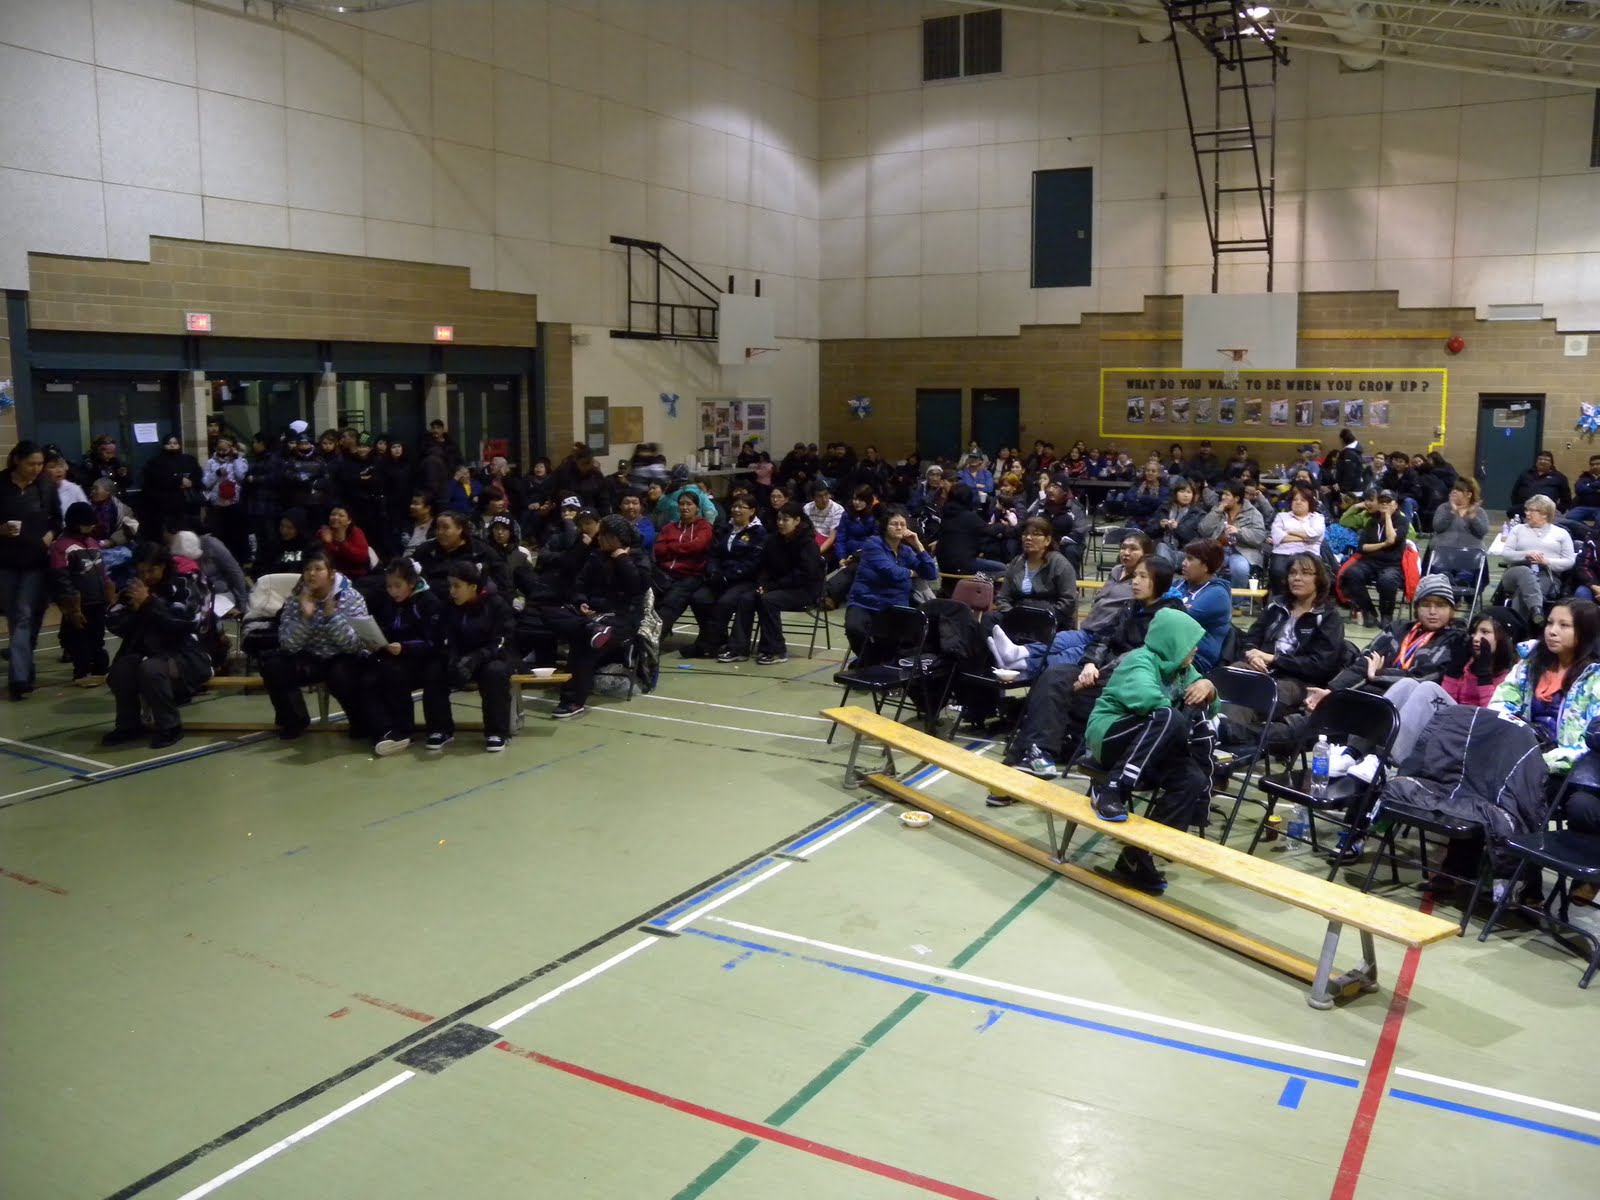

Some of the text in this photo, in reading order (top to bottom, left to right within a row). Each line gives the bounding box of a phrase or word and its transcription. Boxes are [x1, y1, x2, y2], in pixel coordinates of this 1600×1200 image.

[1126, 378, 1156, 390] WHAT
[1160, 379, 1175, 390] DO
[1179, 379, 1201, 390] YOU
[1246, 379, 1262, 391] TO
[1266, 379, 1280, 391] BE
[1286, 379, 1321, 391] WHEN
[1327, 379, 1353, 392] YOU
